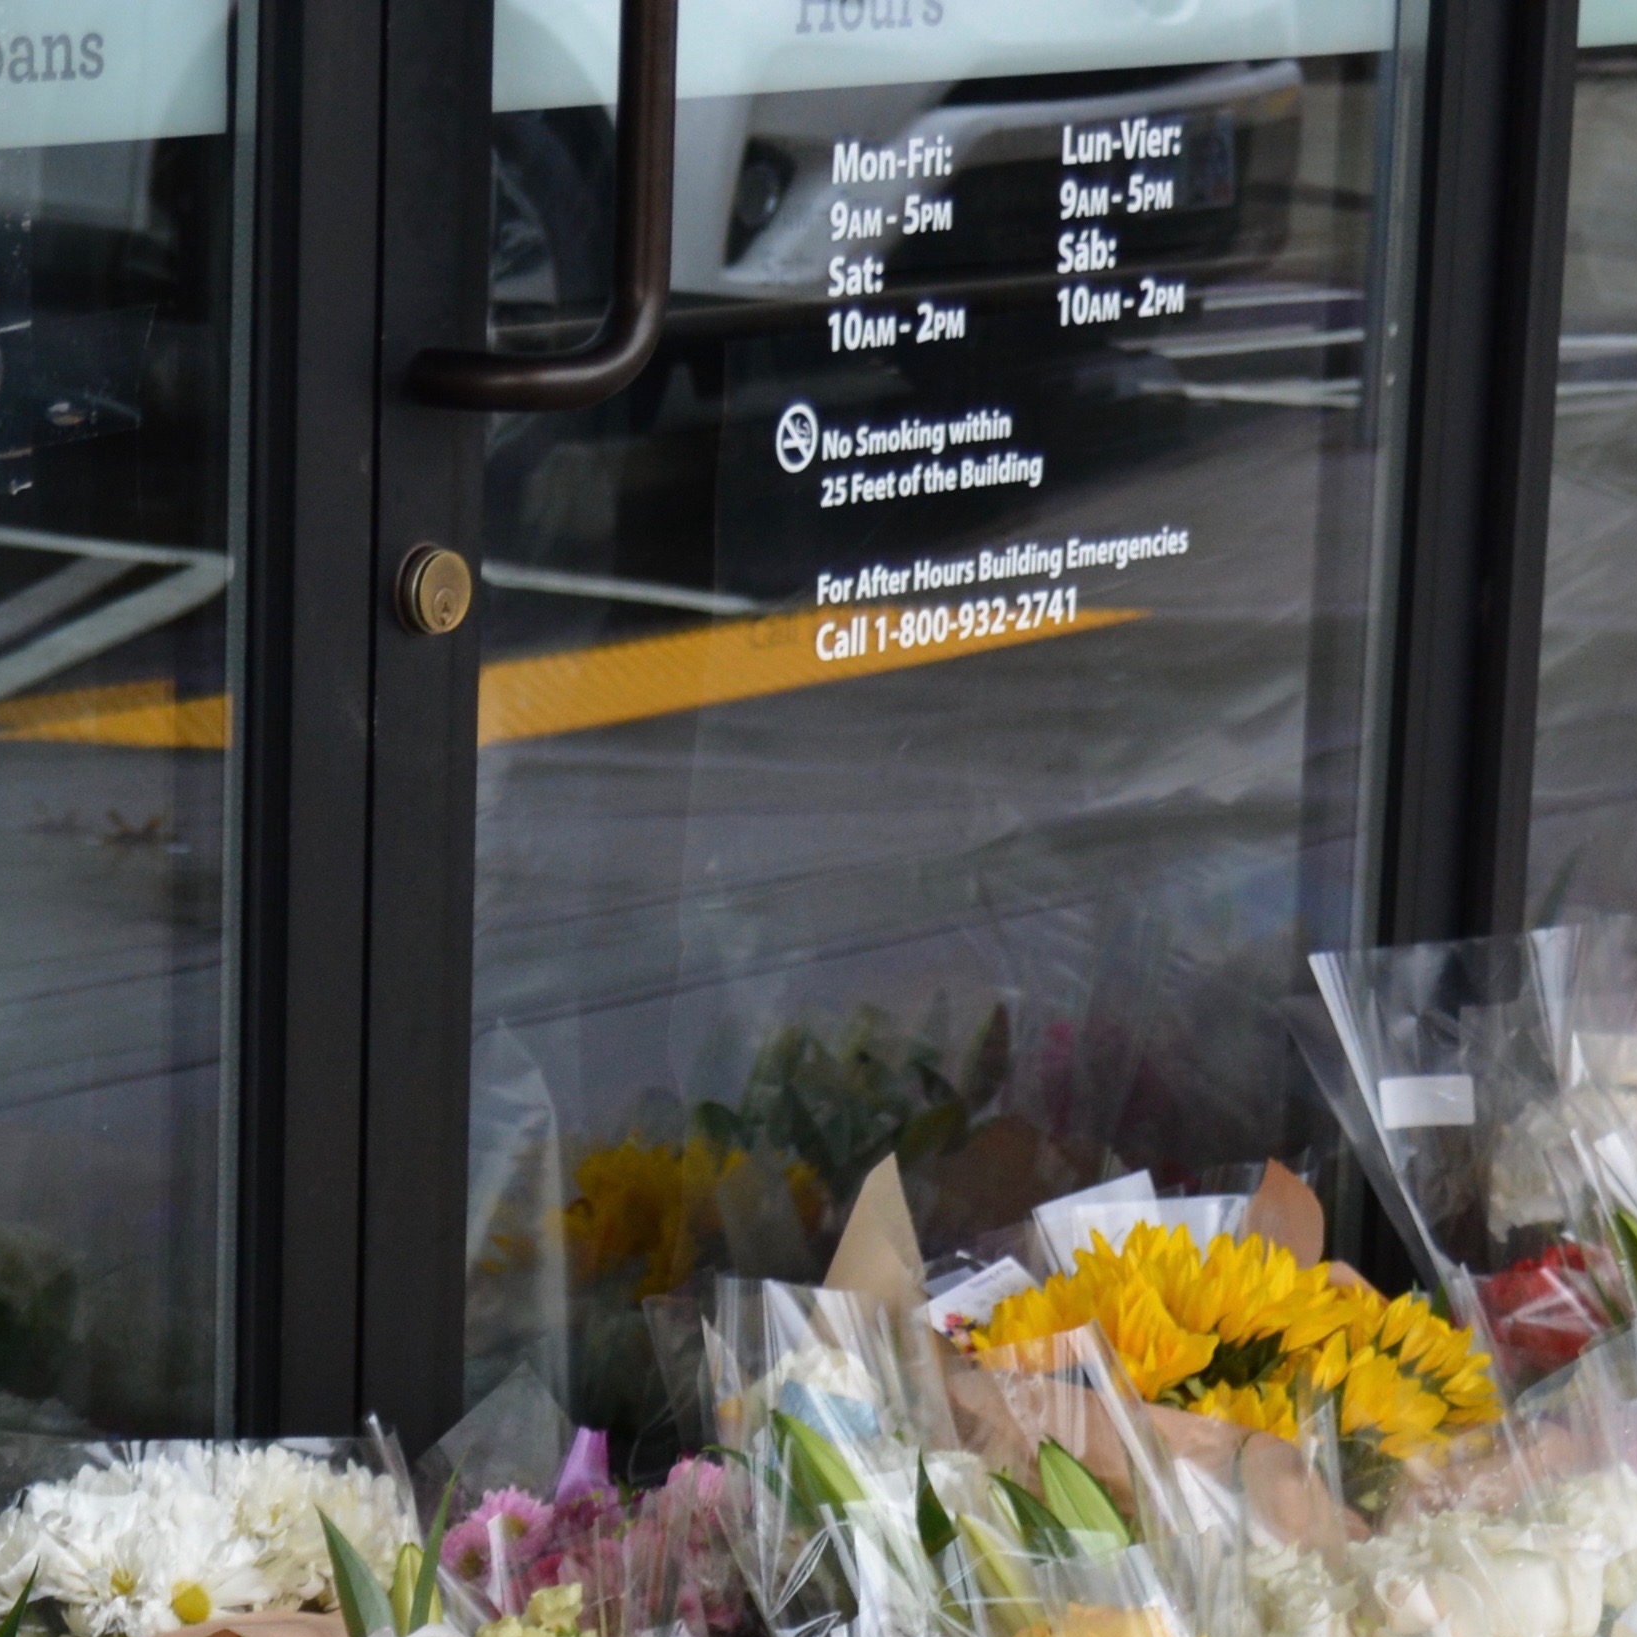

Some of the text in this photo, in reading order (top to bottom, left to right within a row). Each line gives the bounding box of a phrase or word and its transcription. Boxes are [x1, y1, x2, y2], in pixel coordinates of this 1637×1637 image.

[832, 135, 953, 185] Mon-Fri:
[1062, 118, 1182, 166] Lun-Vier:
[828, 255, 884, 297] Sat:
[1057, 228, 1117, 274] Sáb:
[822, 409, 1013, 461] No Smoking within
[820, 452, 1043, 508] 25 Feet of the Building
[817, 525, 1189, 606] For After Hours Building Emergencies
[815, 586, 1078, 662] Call 1-800-932-2741
